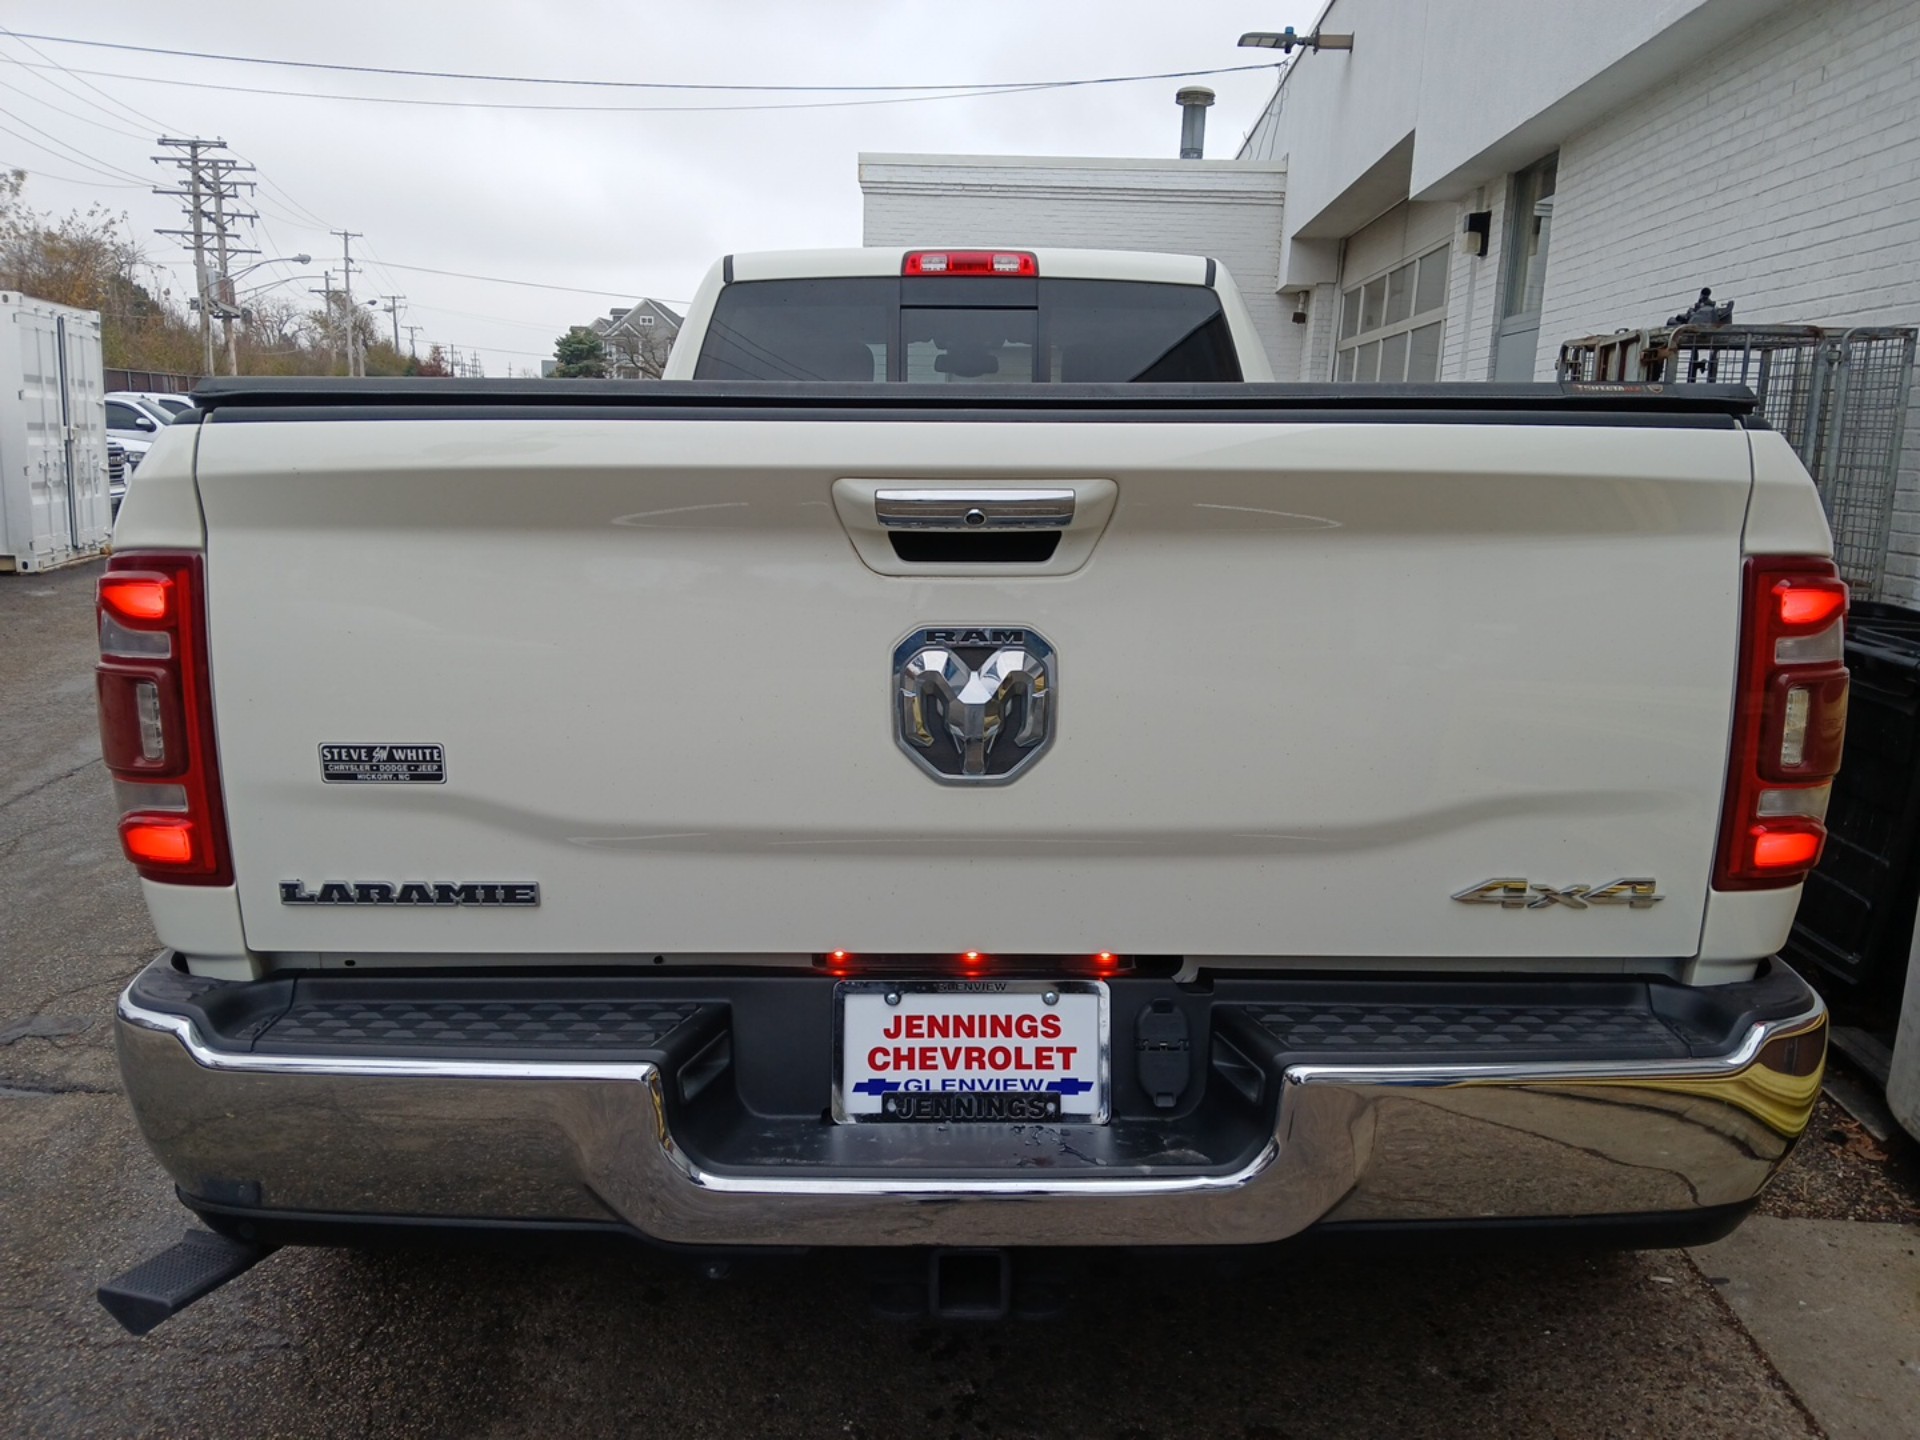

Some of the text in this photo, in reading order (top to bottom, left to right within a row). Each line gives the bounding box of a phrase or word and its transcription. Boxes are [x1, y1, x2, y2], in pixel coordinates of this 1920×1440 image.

[925, 631, 1025, 644] RAM
[323, 748, 368, 760] STEVE
[392, 749, 441, 761] WHITE
[328, 764, 370, 772] CHRYSLER
[379, 764, 408, 772] DODGE
[279, 880, 540, 907] LARAMIE
[937, 982, 1007, 993] GLENVIEW
[883, 1014, 1062, 1040] JENNINGS
[867, 1046, 1077, 1072] CHEVROLET
[903, 1078, 1044, 1092] GLENVIEW
[896, 1096, 1046, 1119] JENNINGS
